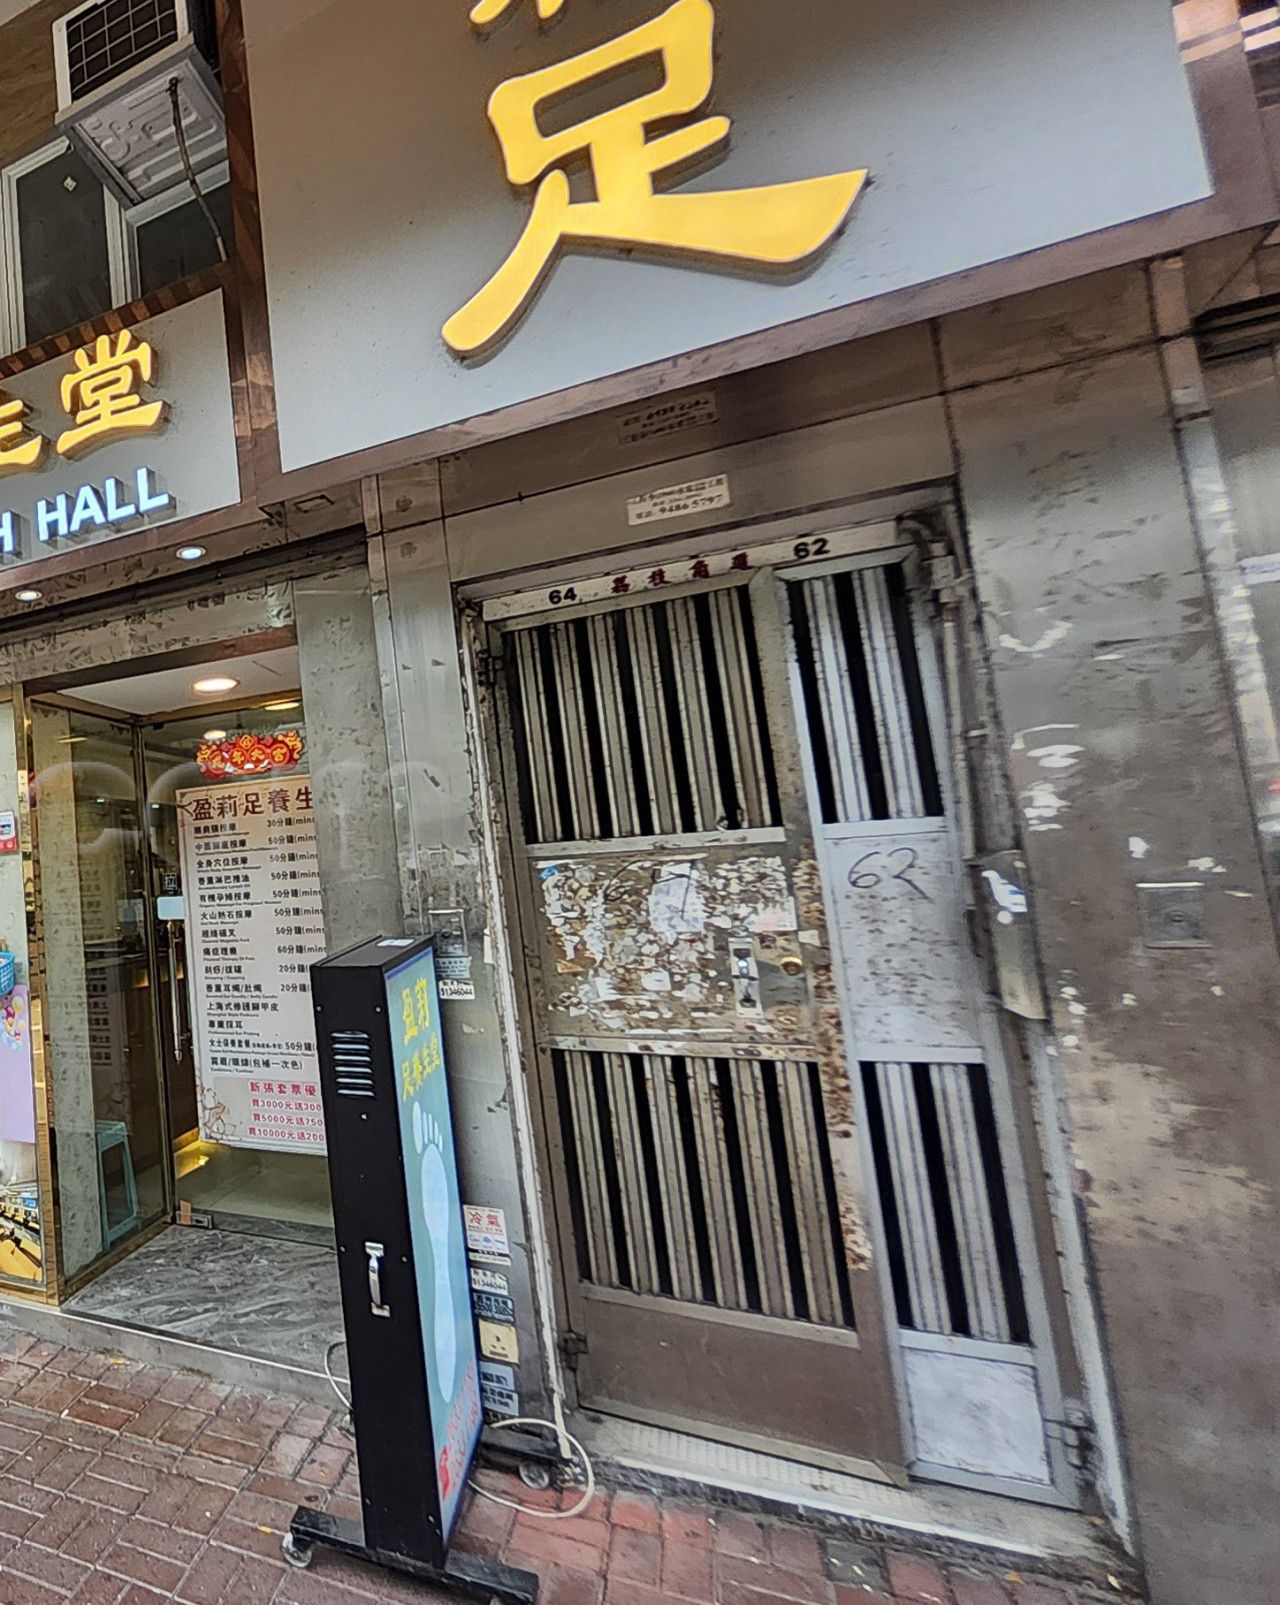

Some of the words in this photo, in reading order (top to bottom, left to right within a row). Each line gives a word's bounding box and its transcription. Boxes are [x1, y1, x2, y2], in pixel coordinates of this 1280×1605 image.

[440, 0, 870, 352] 足
[37, 467, 170, 541] HALL
[548, 586, 577, 605] 64
[793, 537, 831, 560] 62
[192, 785, 313, 821] 盈莉足養生
[847, 846, 933, 901] 62
[469, 1211, 500, 1228] 冷氣
